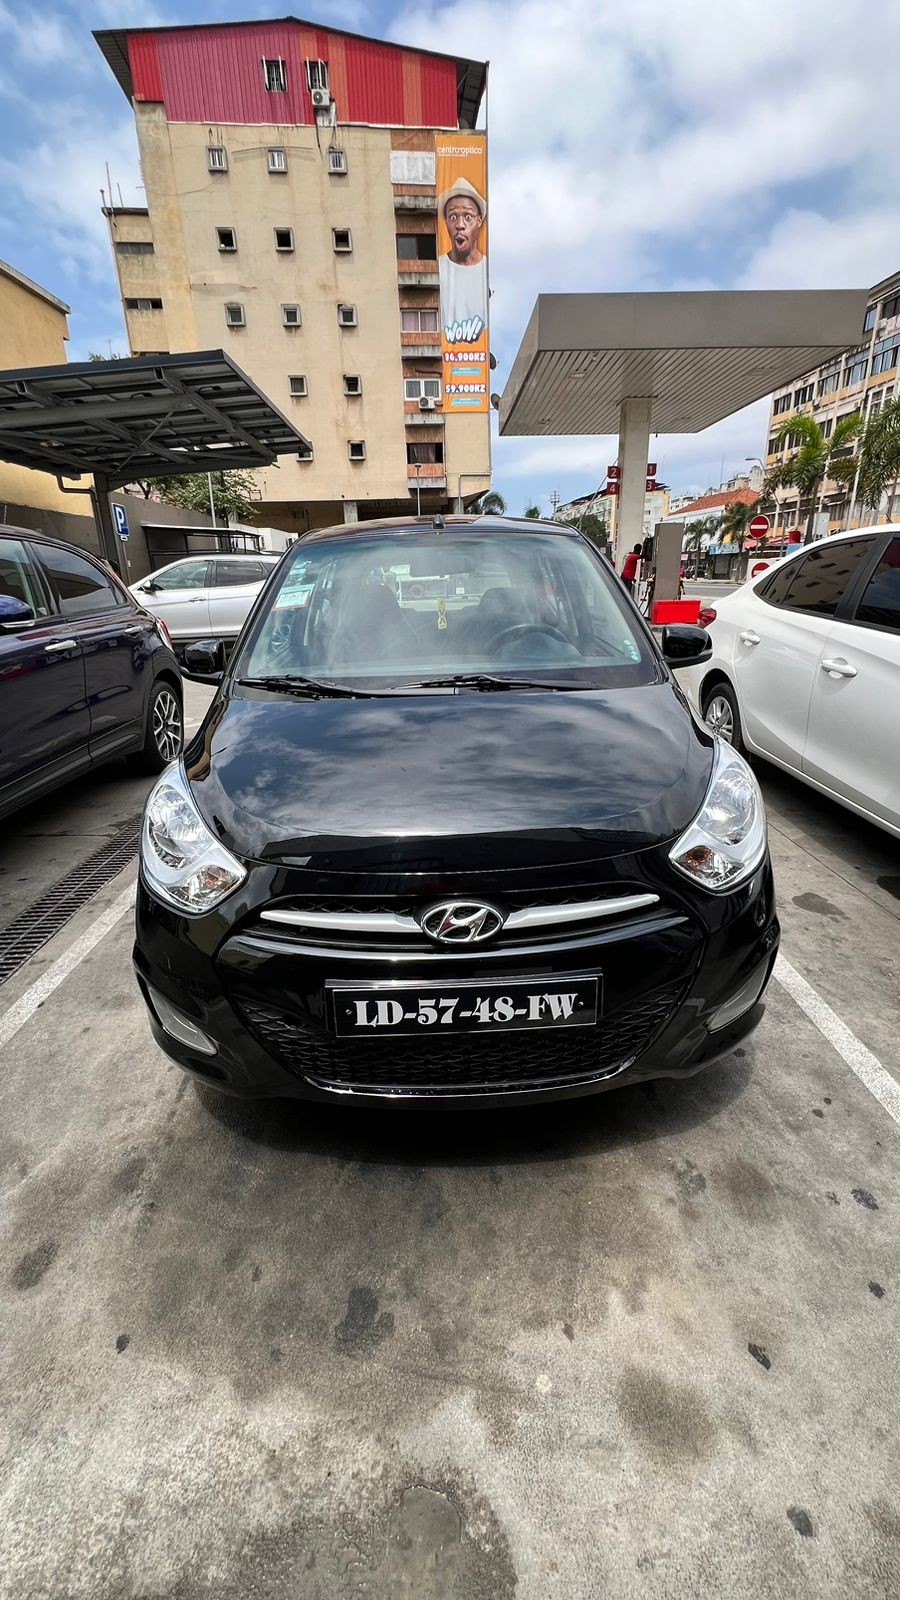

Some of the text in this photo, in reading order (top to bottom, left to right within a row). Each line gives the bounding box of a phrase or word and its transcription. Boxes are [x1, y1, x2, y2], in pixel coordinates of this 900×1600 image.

[445, 384, 486, 393] 59.900KZ
[611, 467, 617, 477] 2
[648, 465, 653, 474] 1
[609, 484, 616, 493] 4
[647, 481, 652, 490] 3
[115, 506, 124, 532] P
[353, 993, 578, 1027] LD-57-48-FW
